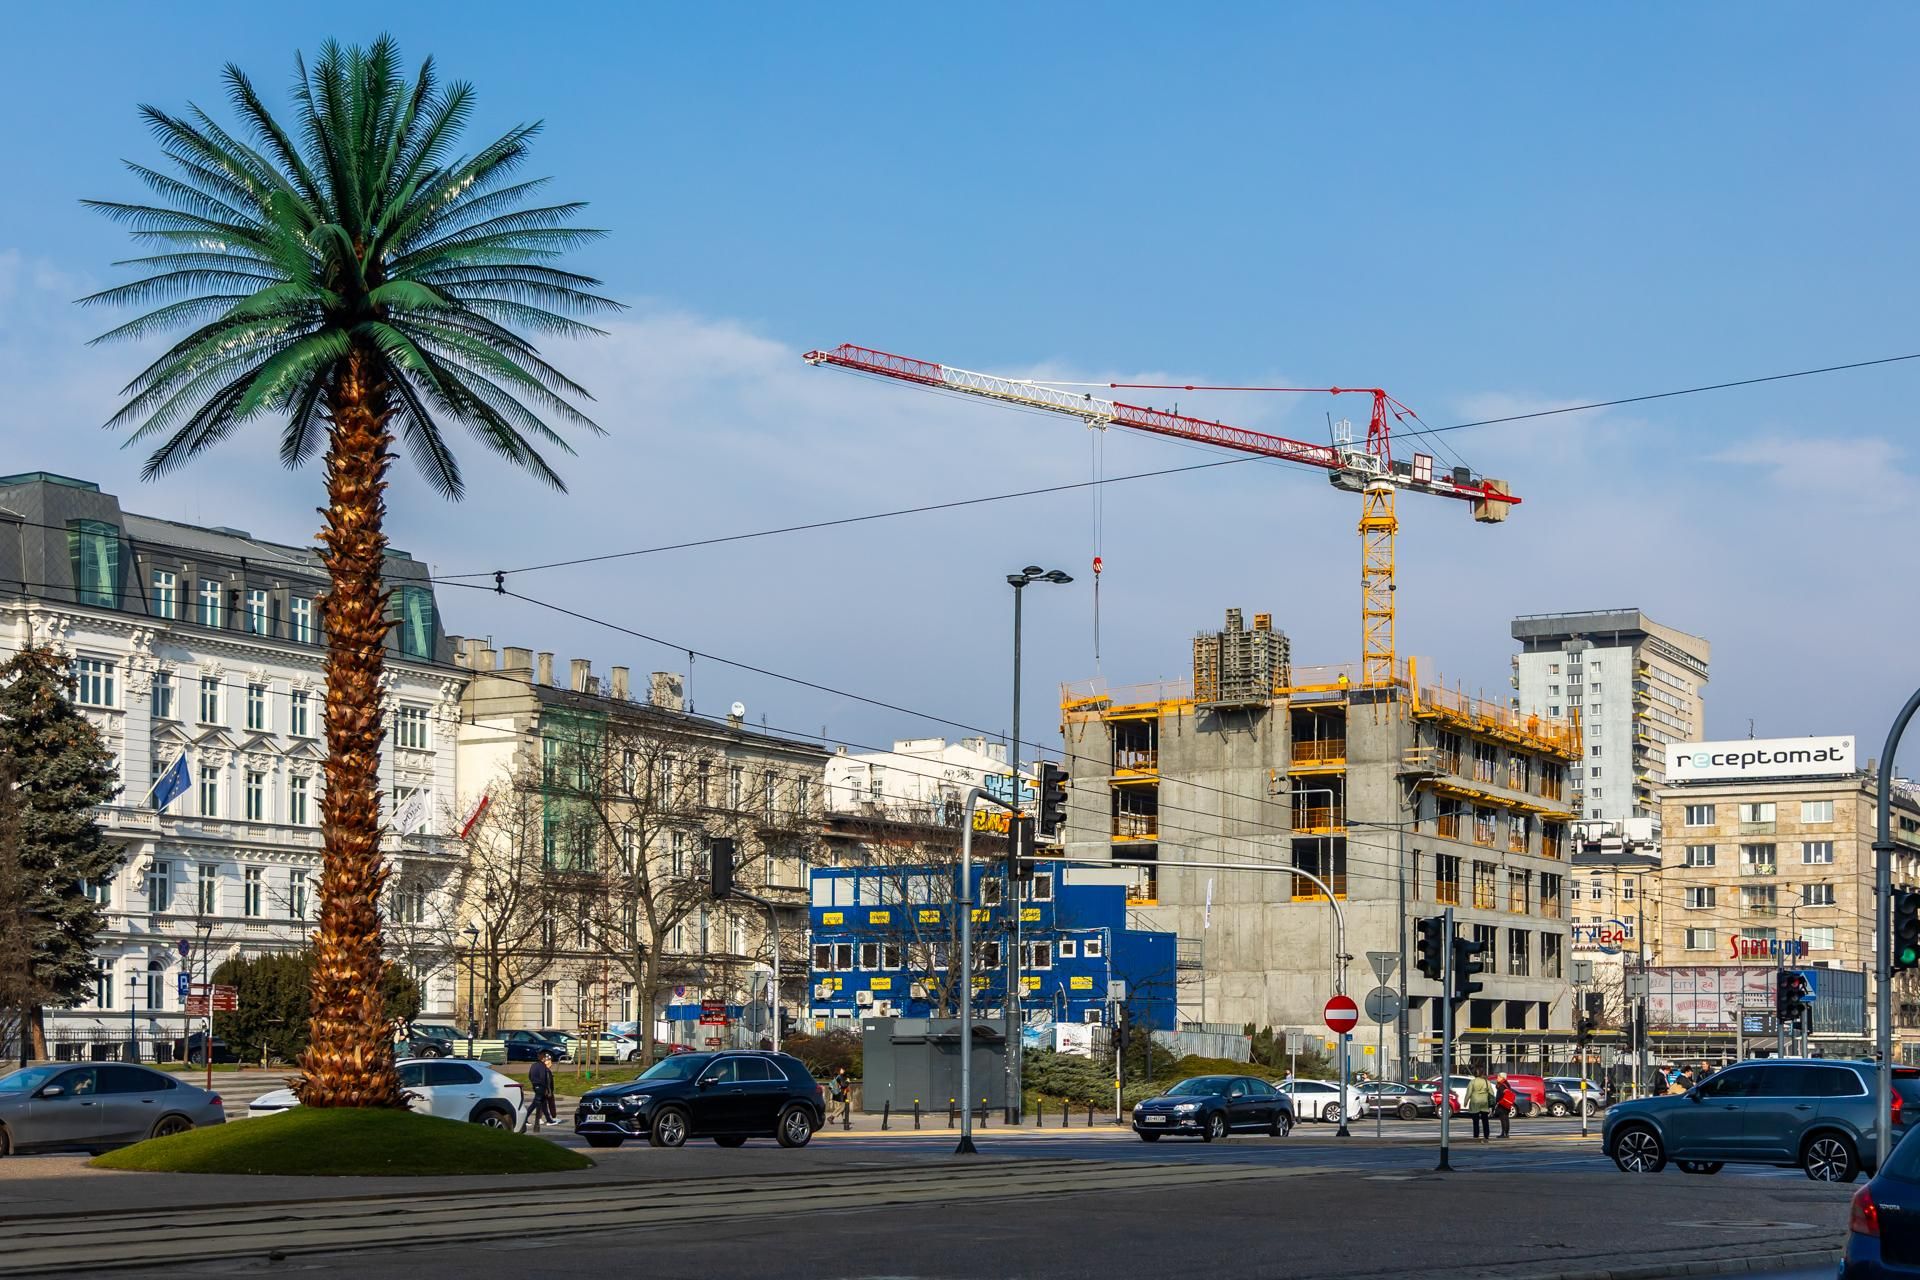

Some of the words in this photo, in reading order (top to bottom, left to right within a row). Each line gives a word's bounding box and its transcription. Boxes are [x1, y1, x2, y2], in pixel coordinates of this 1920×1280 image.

[1676, 747, 1844, 769] receptomat
[1600, 930, 1625, 943] 24
[1673, 981, 1695, 989] CITY
[1702, 981, 1713, 989] 24
